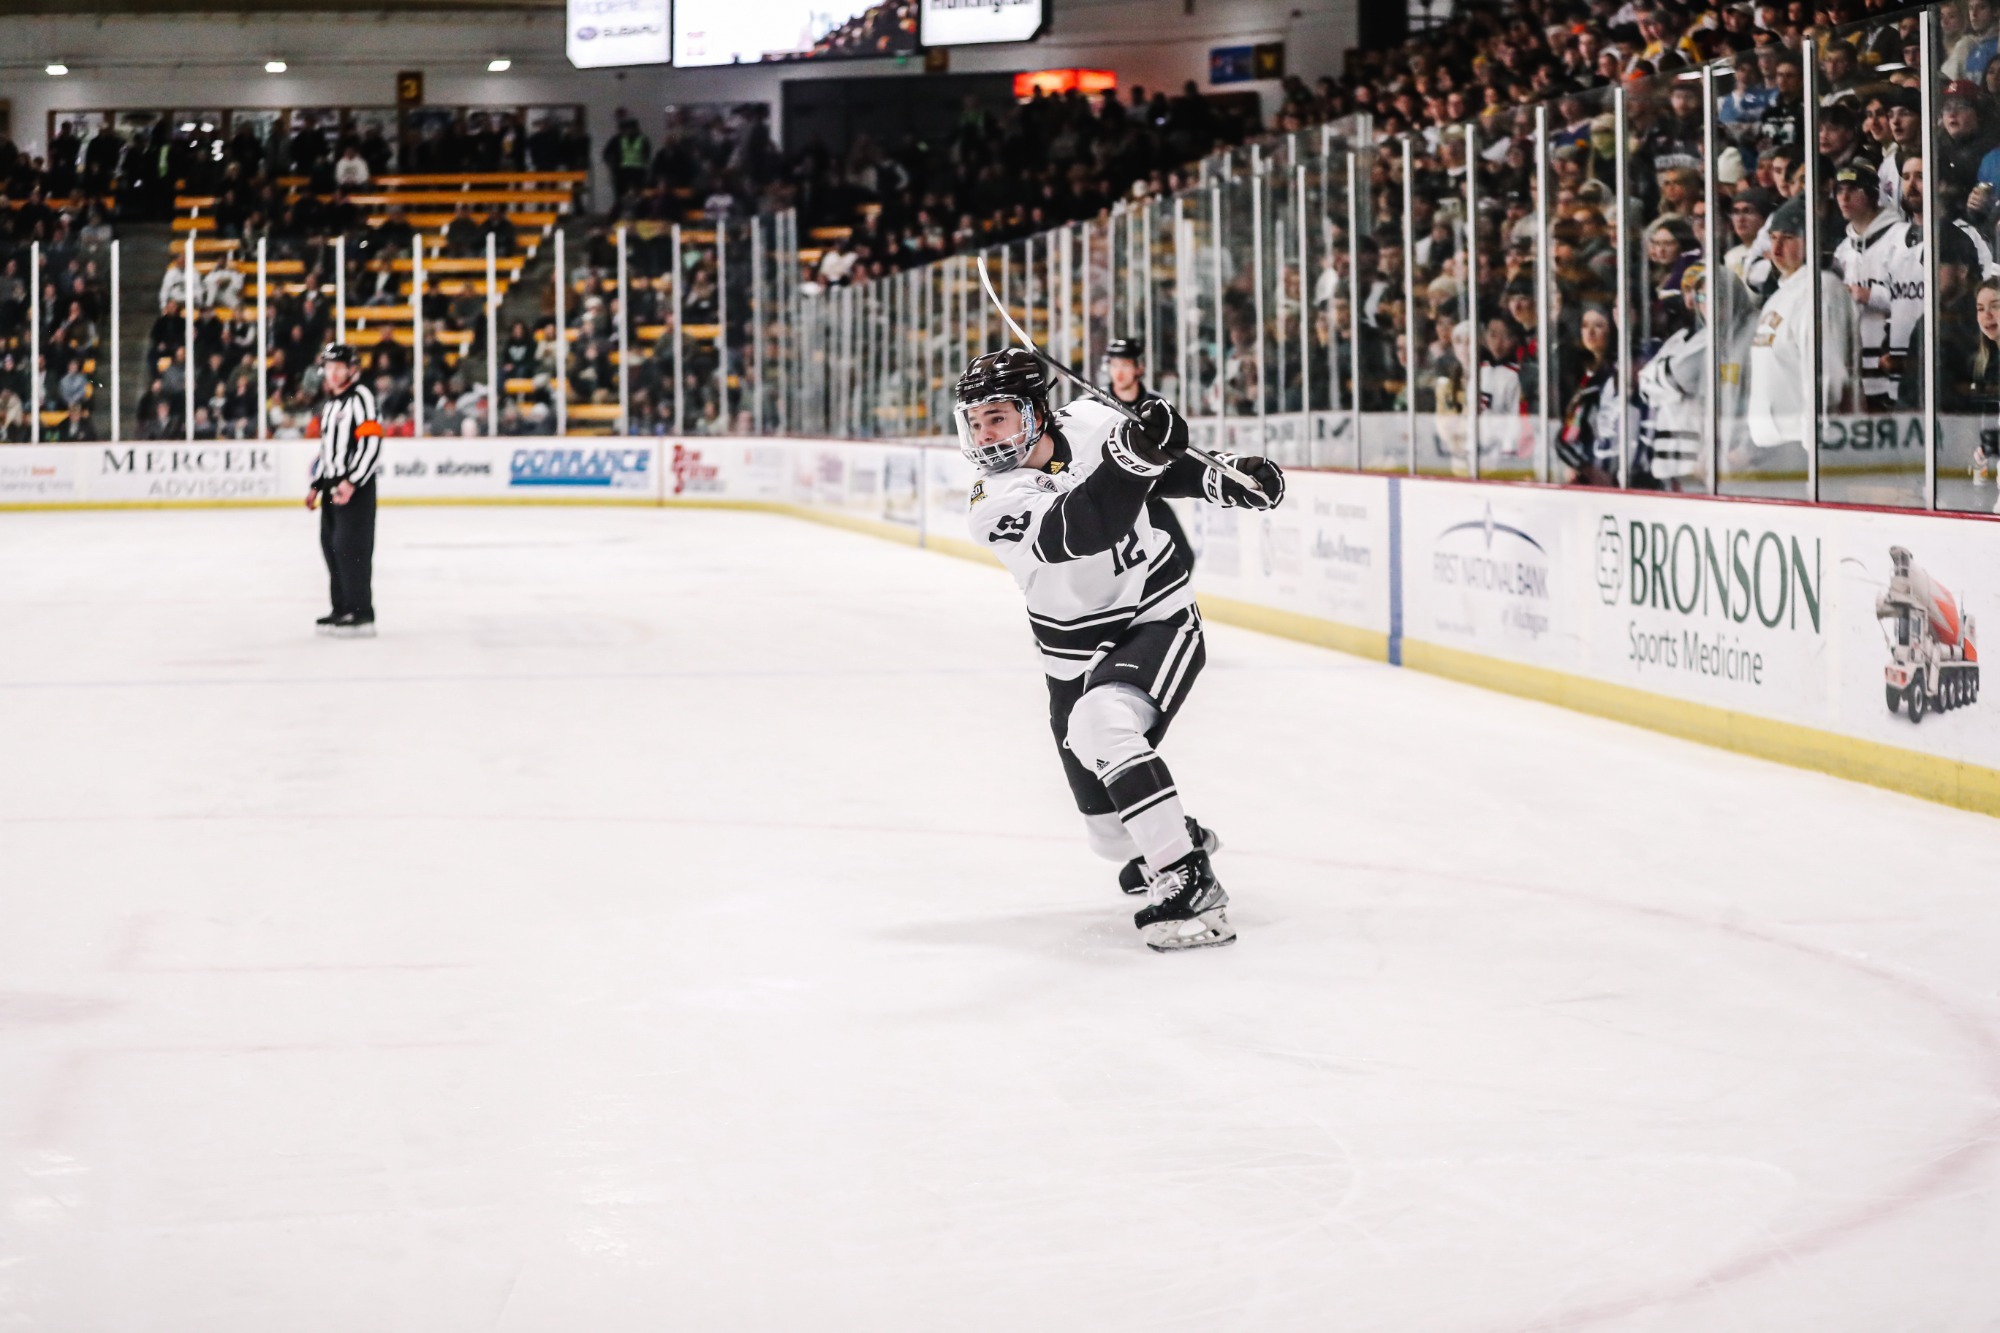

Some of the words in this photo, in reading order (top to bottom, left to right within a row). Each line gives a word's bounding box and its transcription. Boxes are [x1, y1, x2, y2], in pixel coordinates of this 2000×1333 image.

[102, 449, 272, 474] MERCER
[395, 457, 427, 475] sub
[149, 477, 270, 496] ADVISORS
[988, 510, 1032, 543] 12
[1113, 527, 1148, 577] 12
[1433, 551, 1459, 584] FIRST
[1461, 556, 1515, 594] NATIONAL
[1516, 562, 1550, 600] BANK
[1629, 520, 1821, 634] BRONSON
[1629, 620, 1678, 672] Sports
[1683, 629, 1764, 685] Medicine
